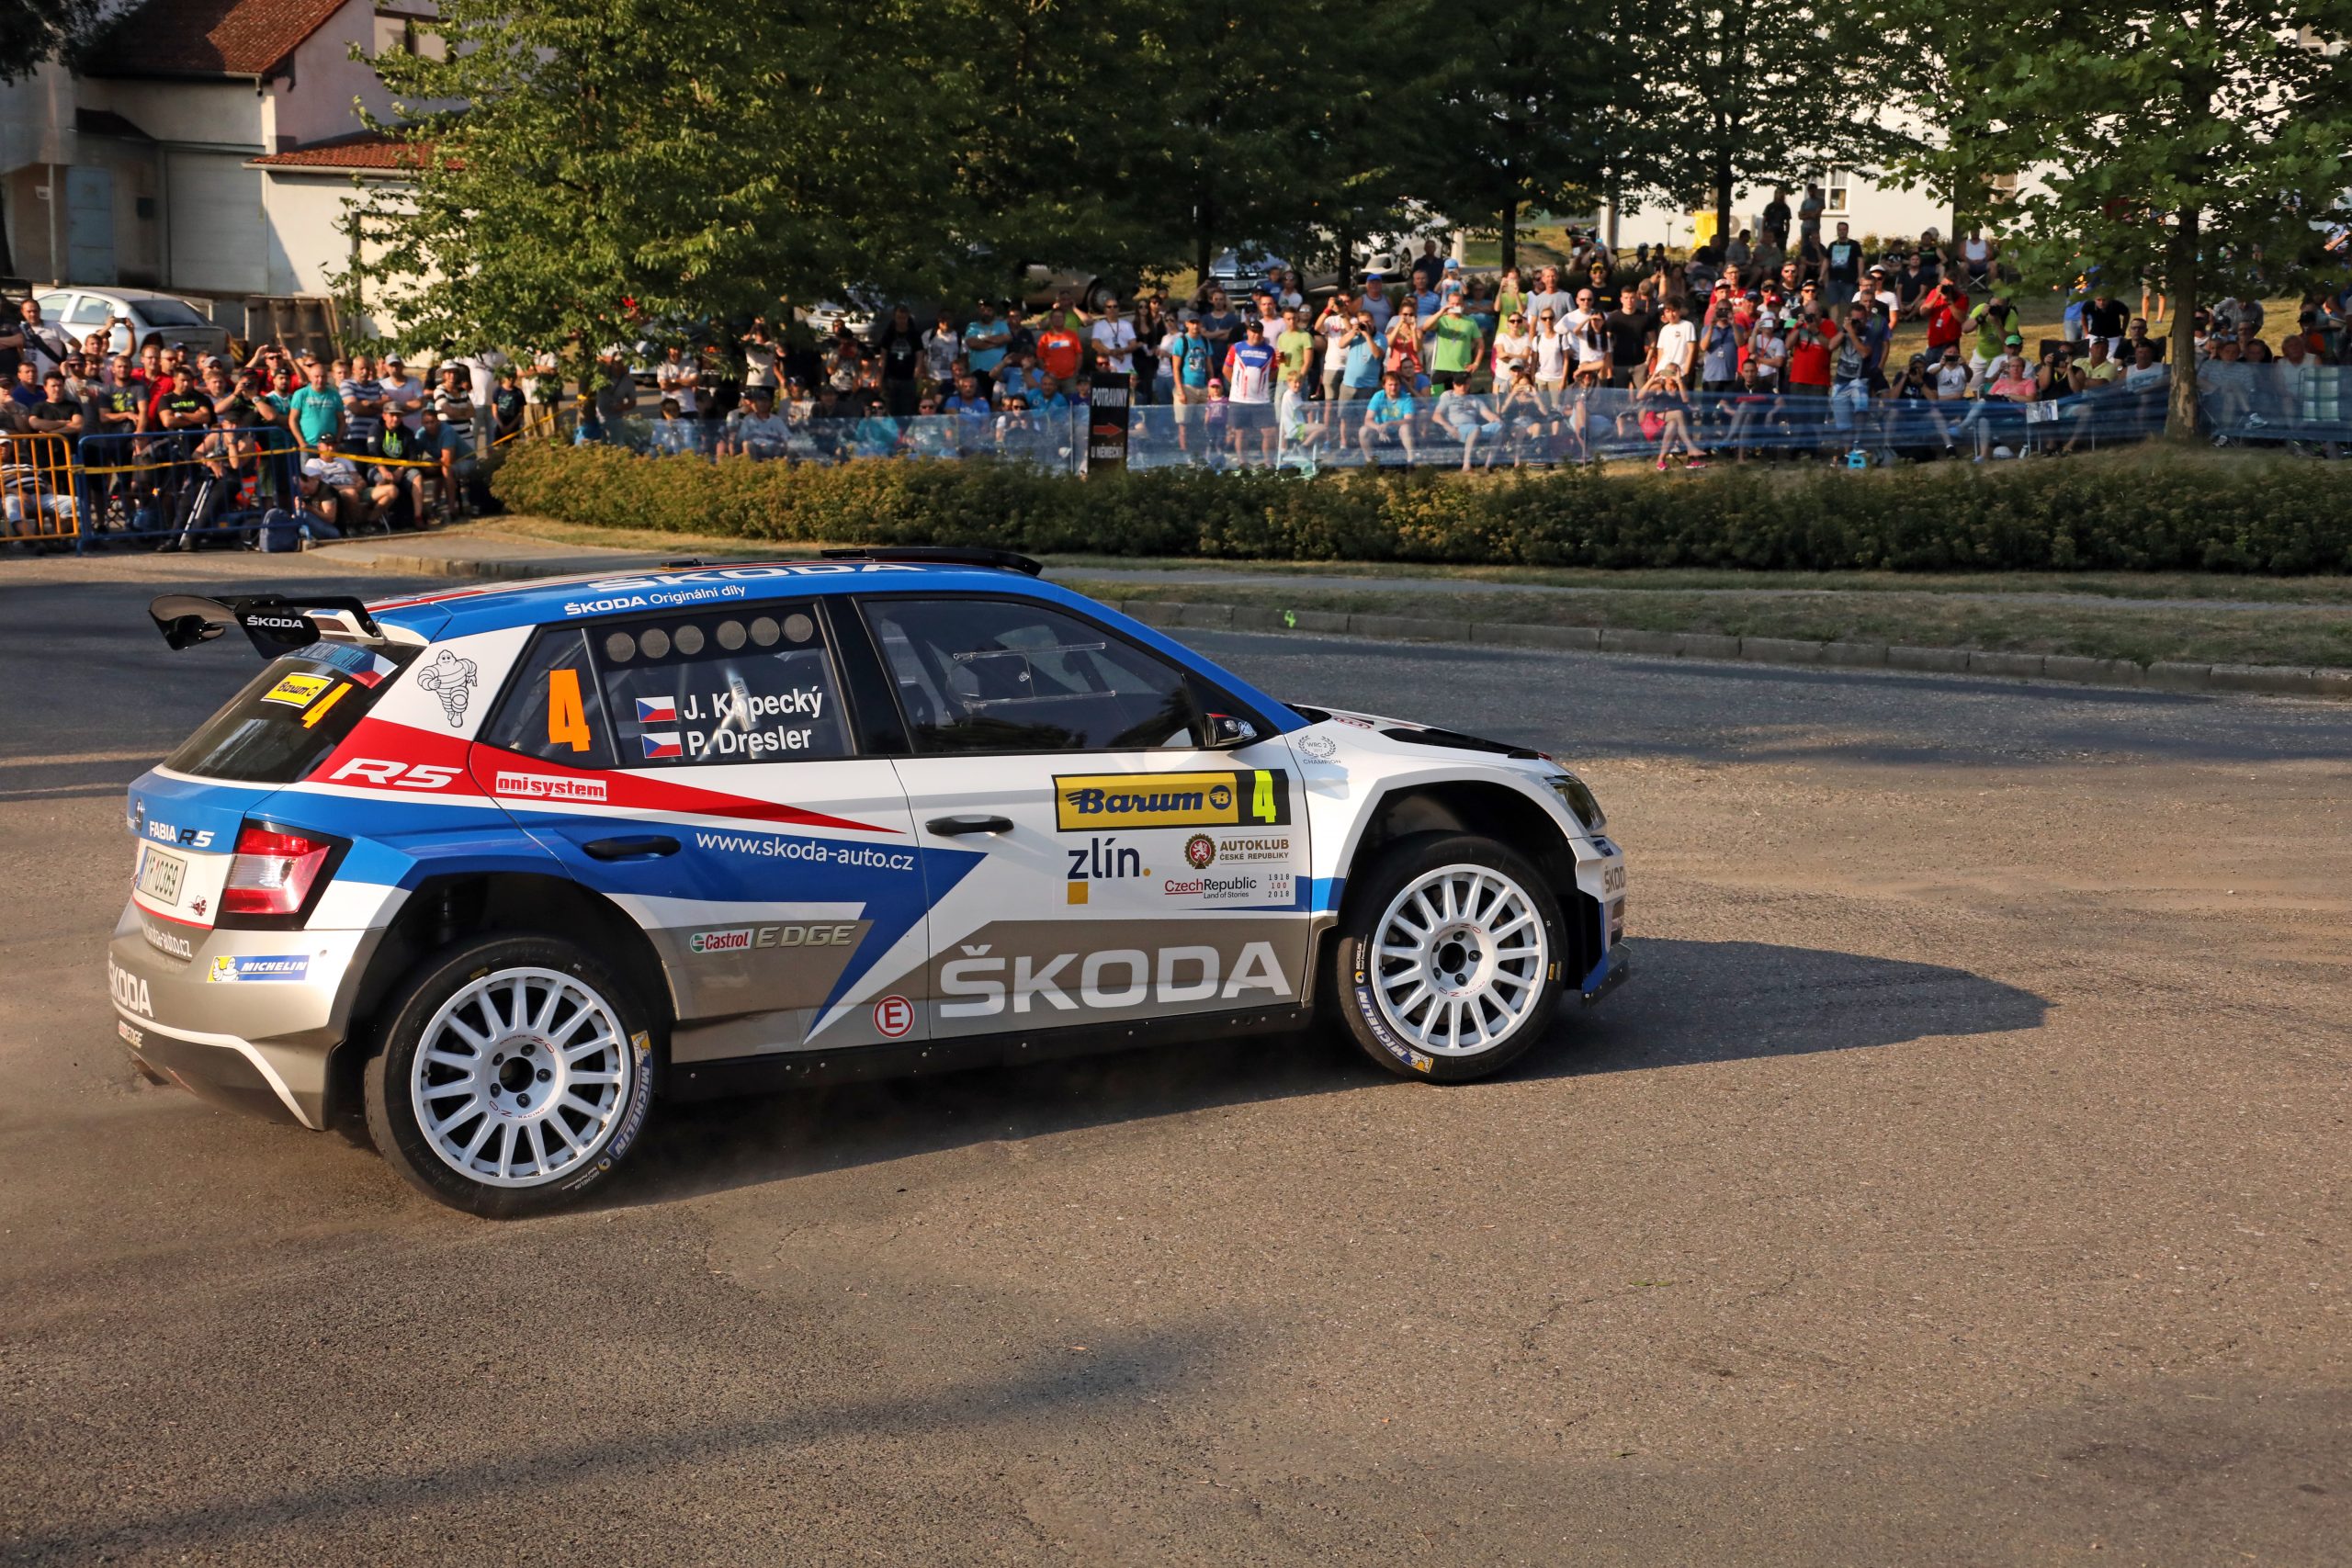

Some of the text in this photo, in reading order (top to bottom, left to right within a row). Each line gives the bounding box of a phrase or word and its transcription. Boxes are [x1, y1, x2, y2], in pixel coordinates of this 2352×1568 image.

[1091, 388, 1128, 407] POTRAVINY
[564, 584, 745, 615] ŠKODA Originální díly
[246, 615, 304, 628] ŠKODA
[548, 669, 591, 752] 4
[684, 694, 707, 720] J.
[712, 685, 822, 723] Kopecký
[687, 726, 812, 756] P. Dresler
[329, 757, 463, 788] R5
[1066, 788, 1203, 815] Barum
[1252, 770, 1277, 823] 4
[149, 820, 215, 848] FABIA R5
[1220, 839, 1289, 852] AUTOKLUB
[695, 832, 914, 871] www.skoda-auto.cz
[1220, 852, 1289, 861] ČESKÉ REPUBLIKY
[1204, 891, 1219, 899] Land
[1604, 866, 1624, 894] ŠKOD
[705, 925, 856, 950] Castrol EDGE
[241, 961, 308, 972] MICHELIN
[939, 941, 1293, 1018] ŠKODA
[1358, 991, 1408, 1057] MICHELIN
[615, 1066, 650, 1156] MICHELIN
